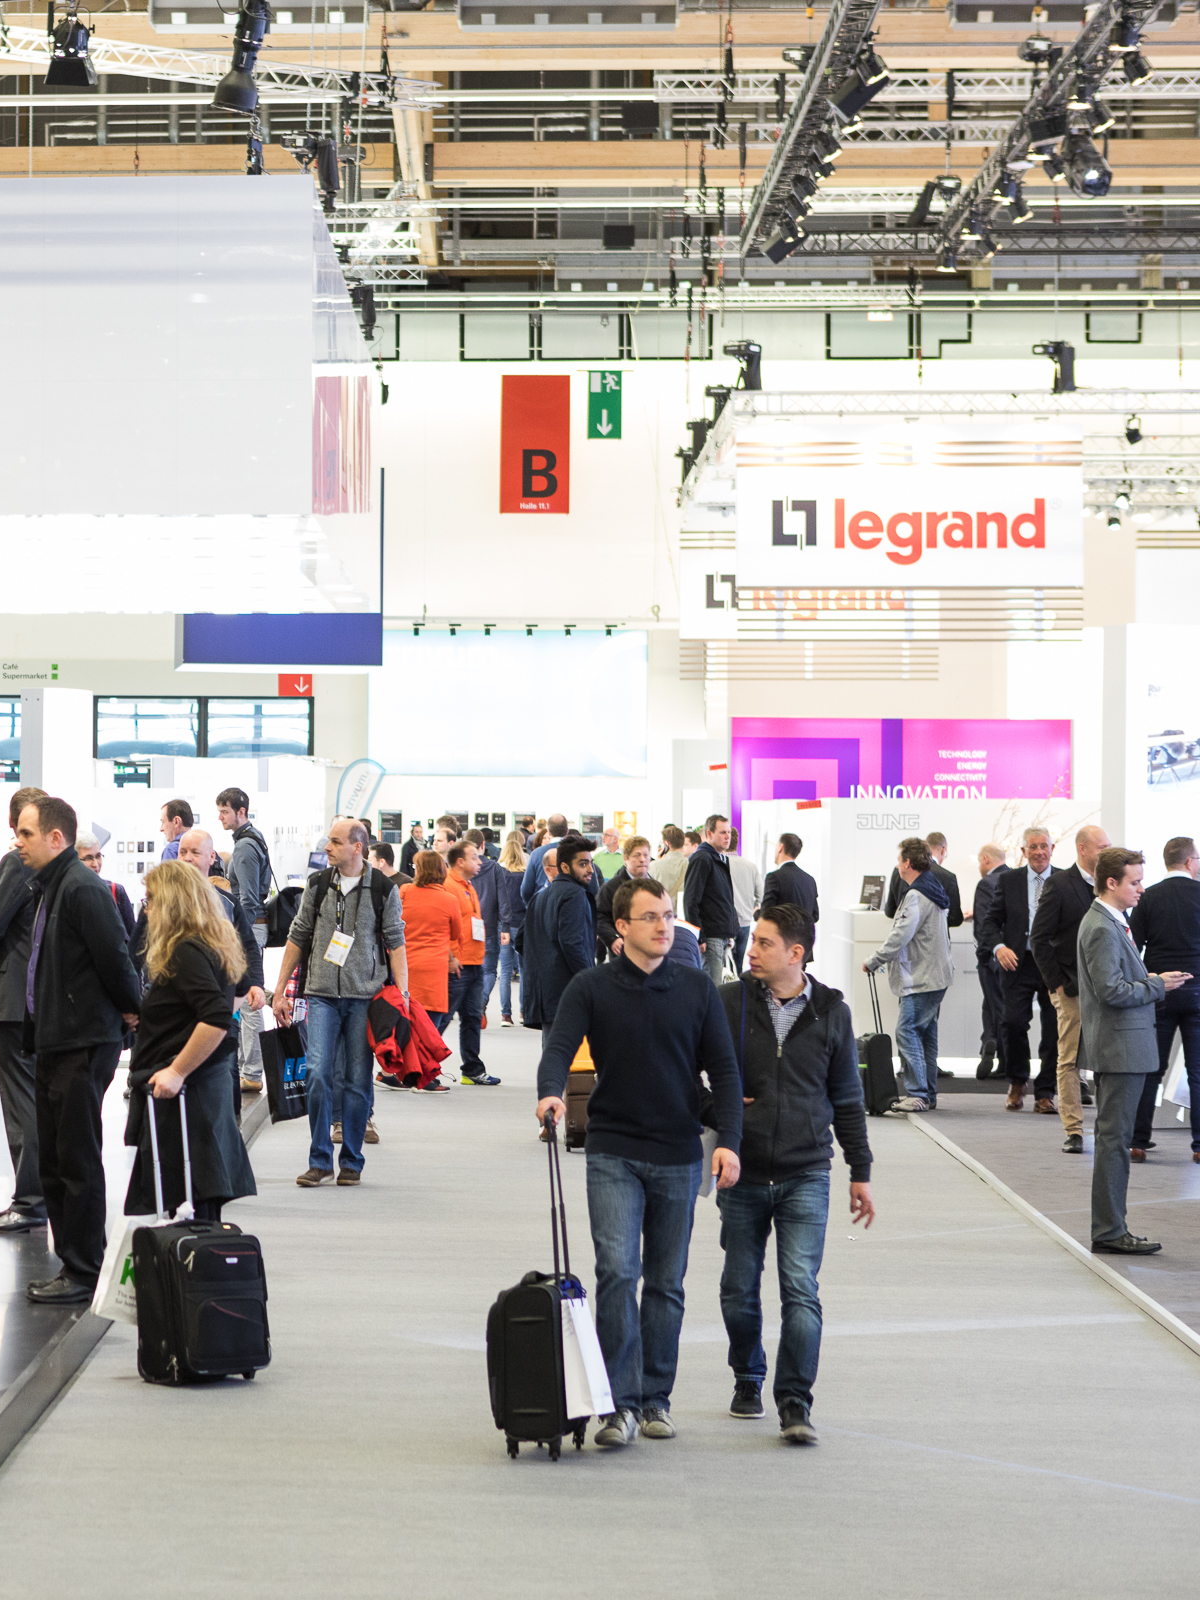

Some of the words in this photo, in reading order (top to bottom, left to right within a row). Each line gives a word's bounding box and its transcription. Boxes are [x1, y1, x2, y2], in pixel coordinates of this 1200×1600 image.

[522, 448, 558, 498] B
[520, 502, 537, 510] Halle
[538, 502, 550, 510] 11.1
[834, 498, 1046, 565] legrand
[937, 750, 987, 759] TECHNOLOGY
[956, 761, 987, 770] ENERGY
[933, 773, 987, 782] CONNECTIVITY
[850, 784, 987, 799] INNOVATION
[857, 813, 919, 830] JUNG
